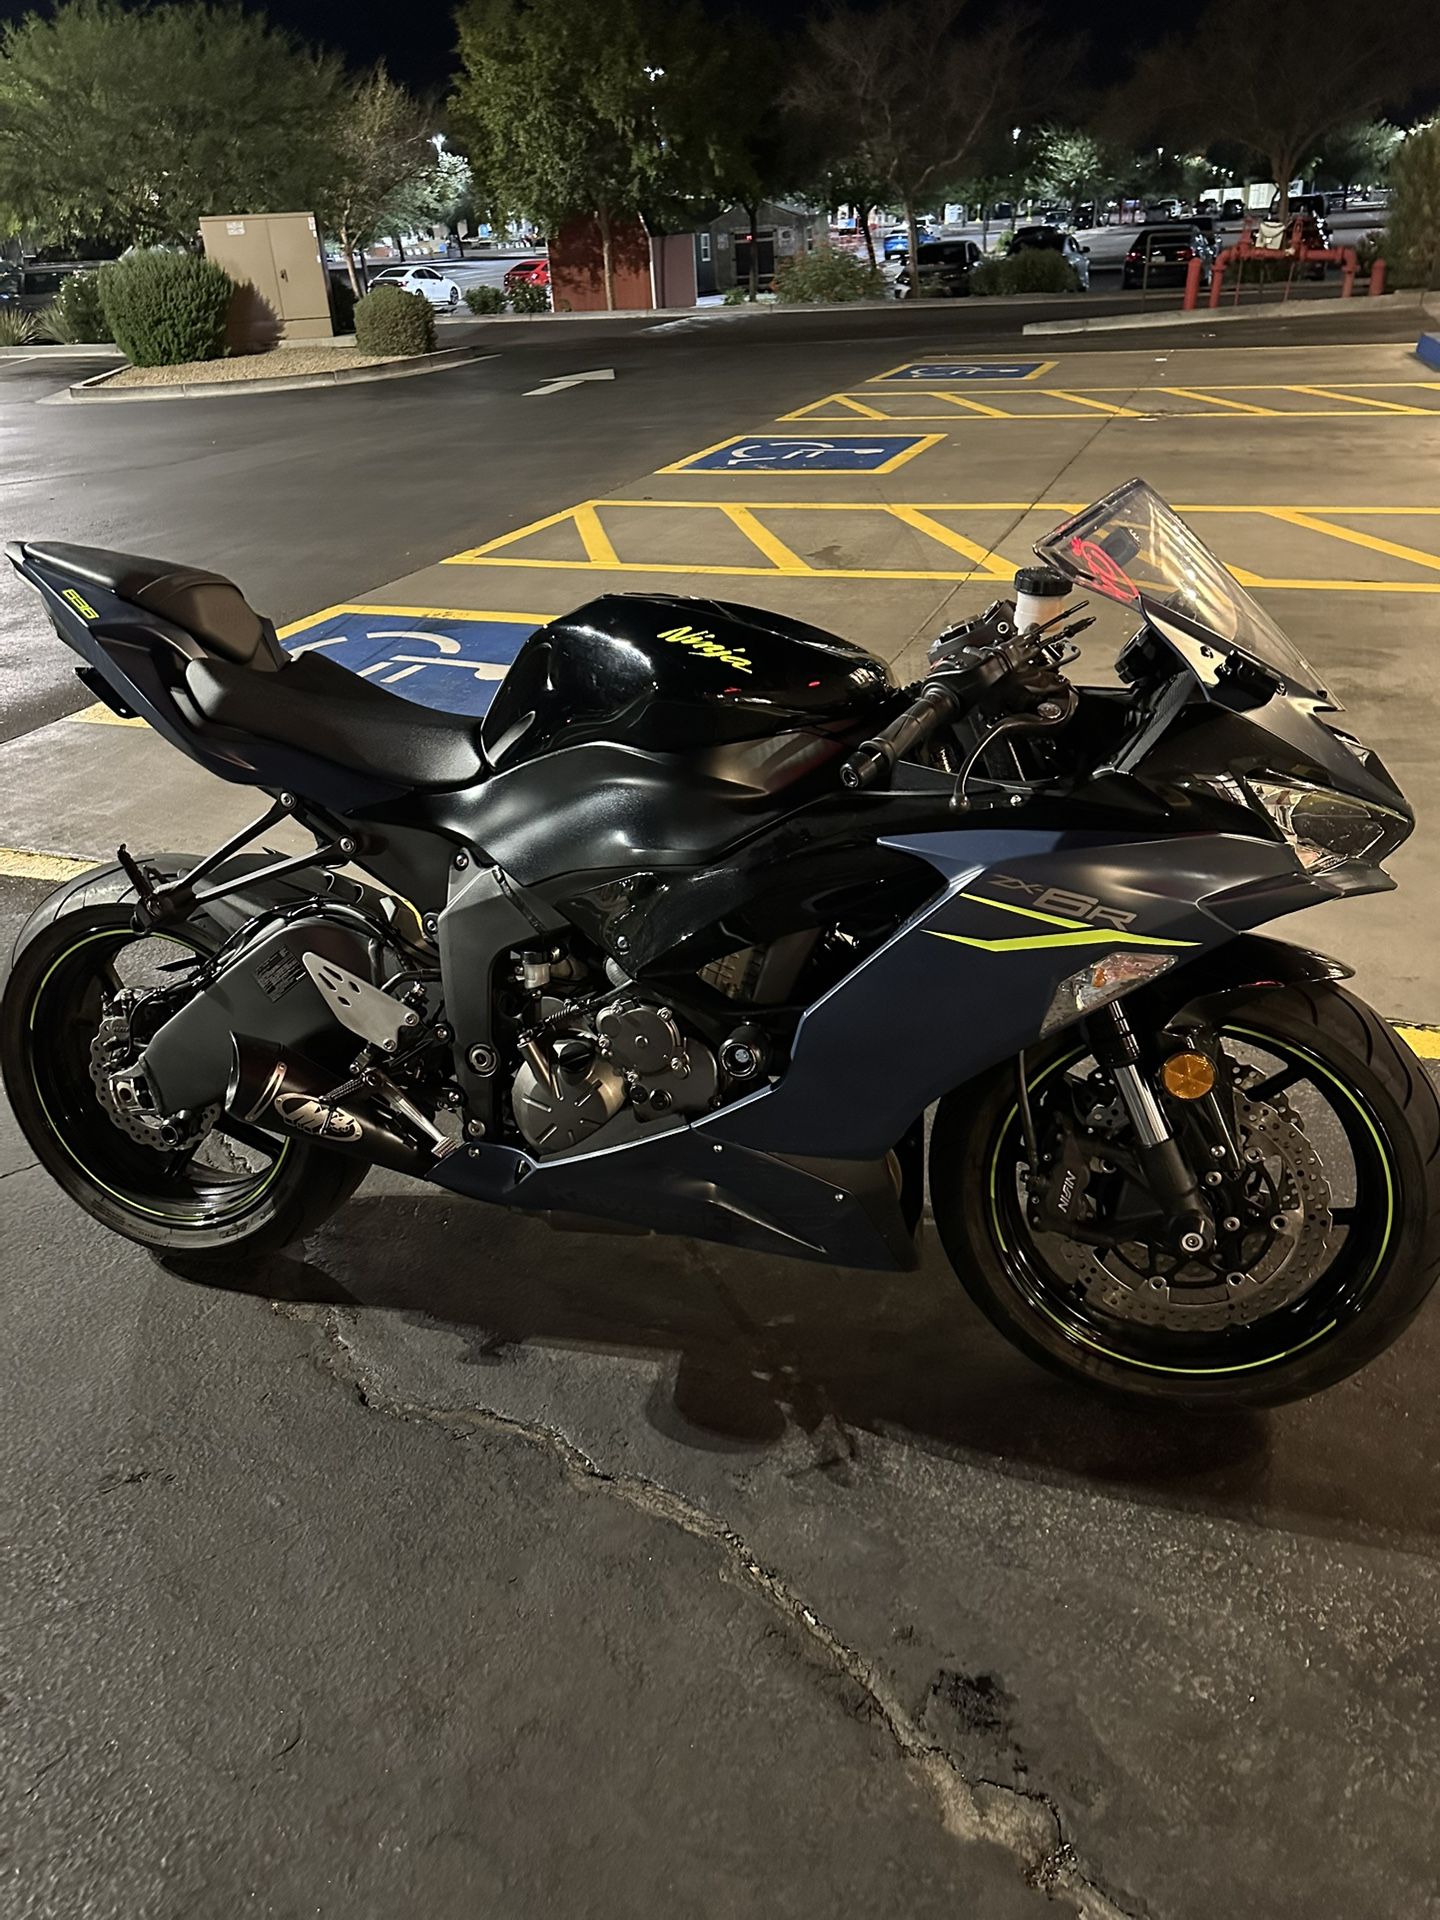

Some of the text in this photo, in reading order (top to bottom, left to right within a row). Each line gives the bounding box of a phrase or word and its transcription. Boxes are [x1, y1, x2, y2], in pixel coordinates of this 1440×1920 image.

[61, 588, 101, 619] 636
[656, 625, 753, 674] Ninja
[986, 873, 1138, 931] ZX-6R
